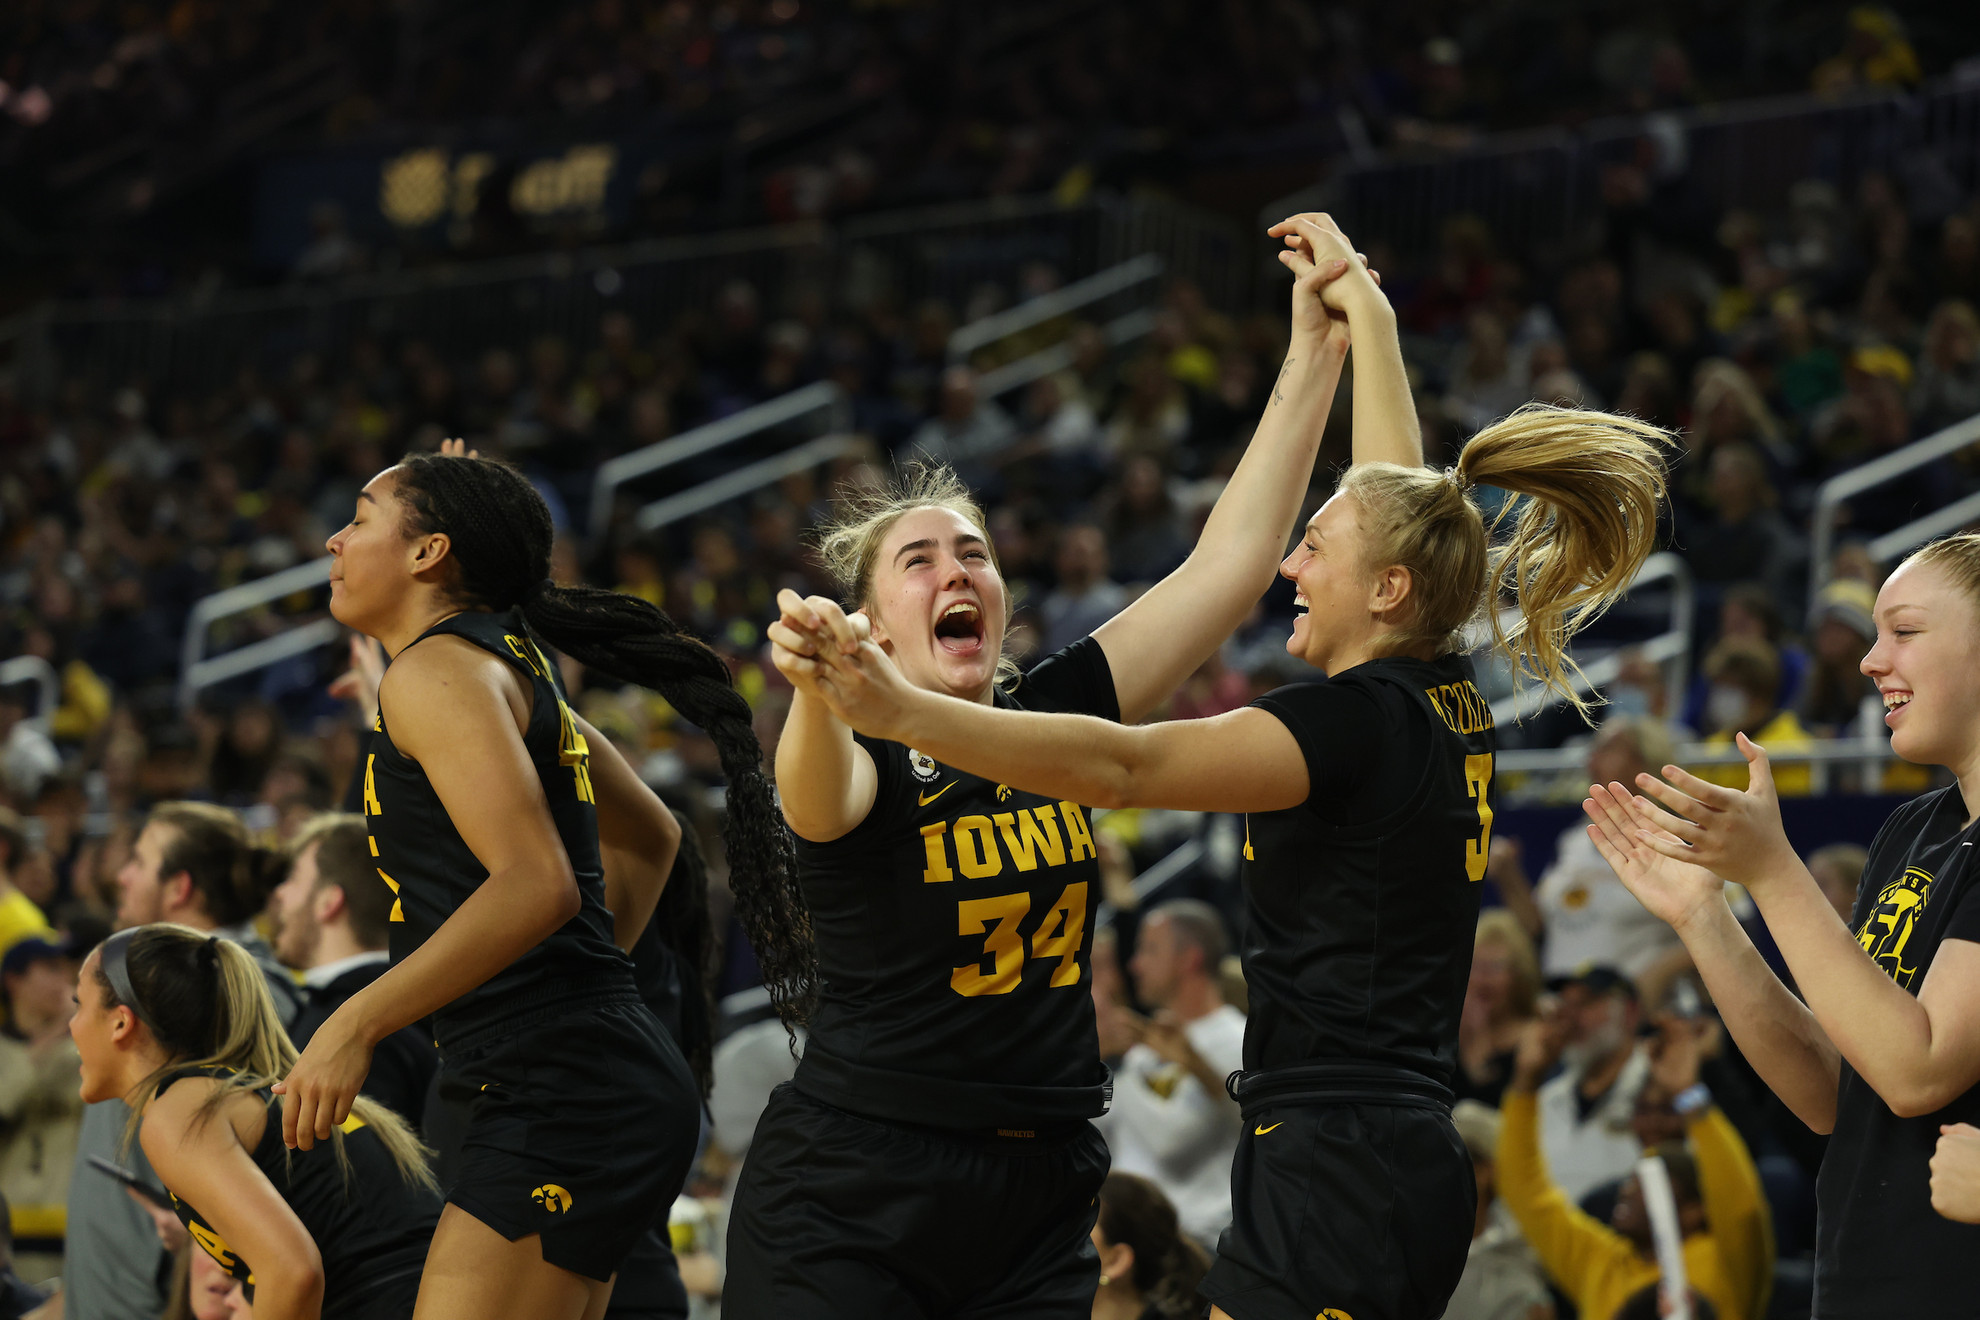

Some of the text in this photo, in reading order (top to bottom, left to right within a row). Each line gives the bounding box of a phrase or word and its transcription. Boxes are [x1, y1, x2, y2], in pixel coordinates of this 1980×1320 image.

[919, 800, 1097, 883] IOWA
[1464, 752, 1494, 883] 3
[950, 881, 1088, 997] 34
[997, 1128, 1036, 1138] HAWKEYES
